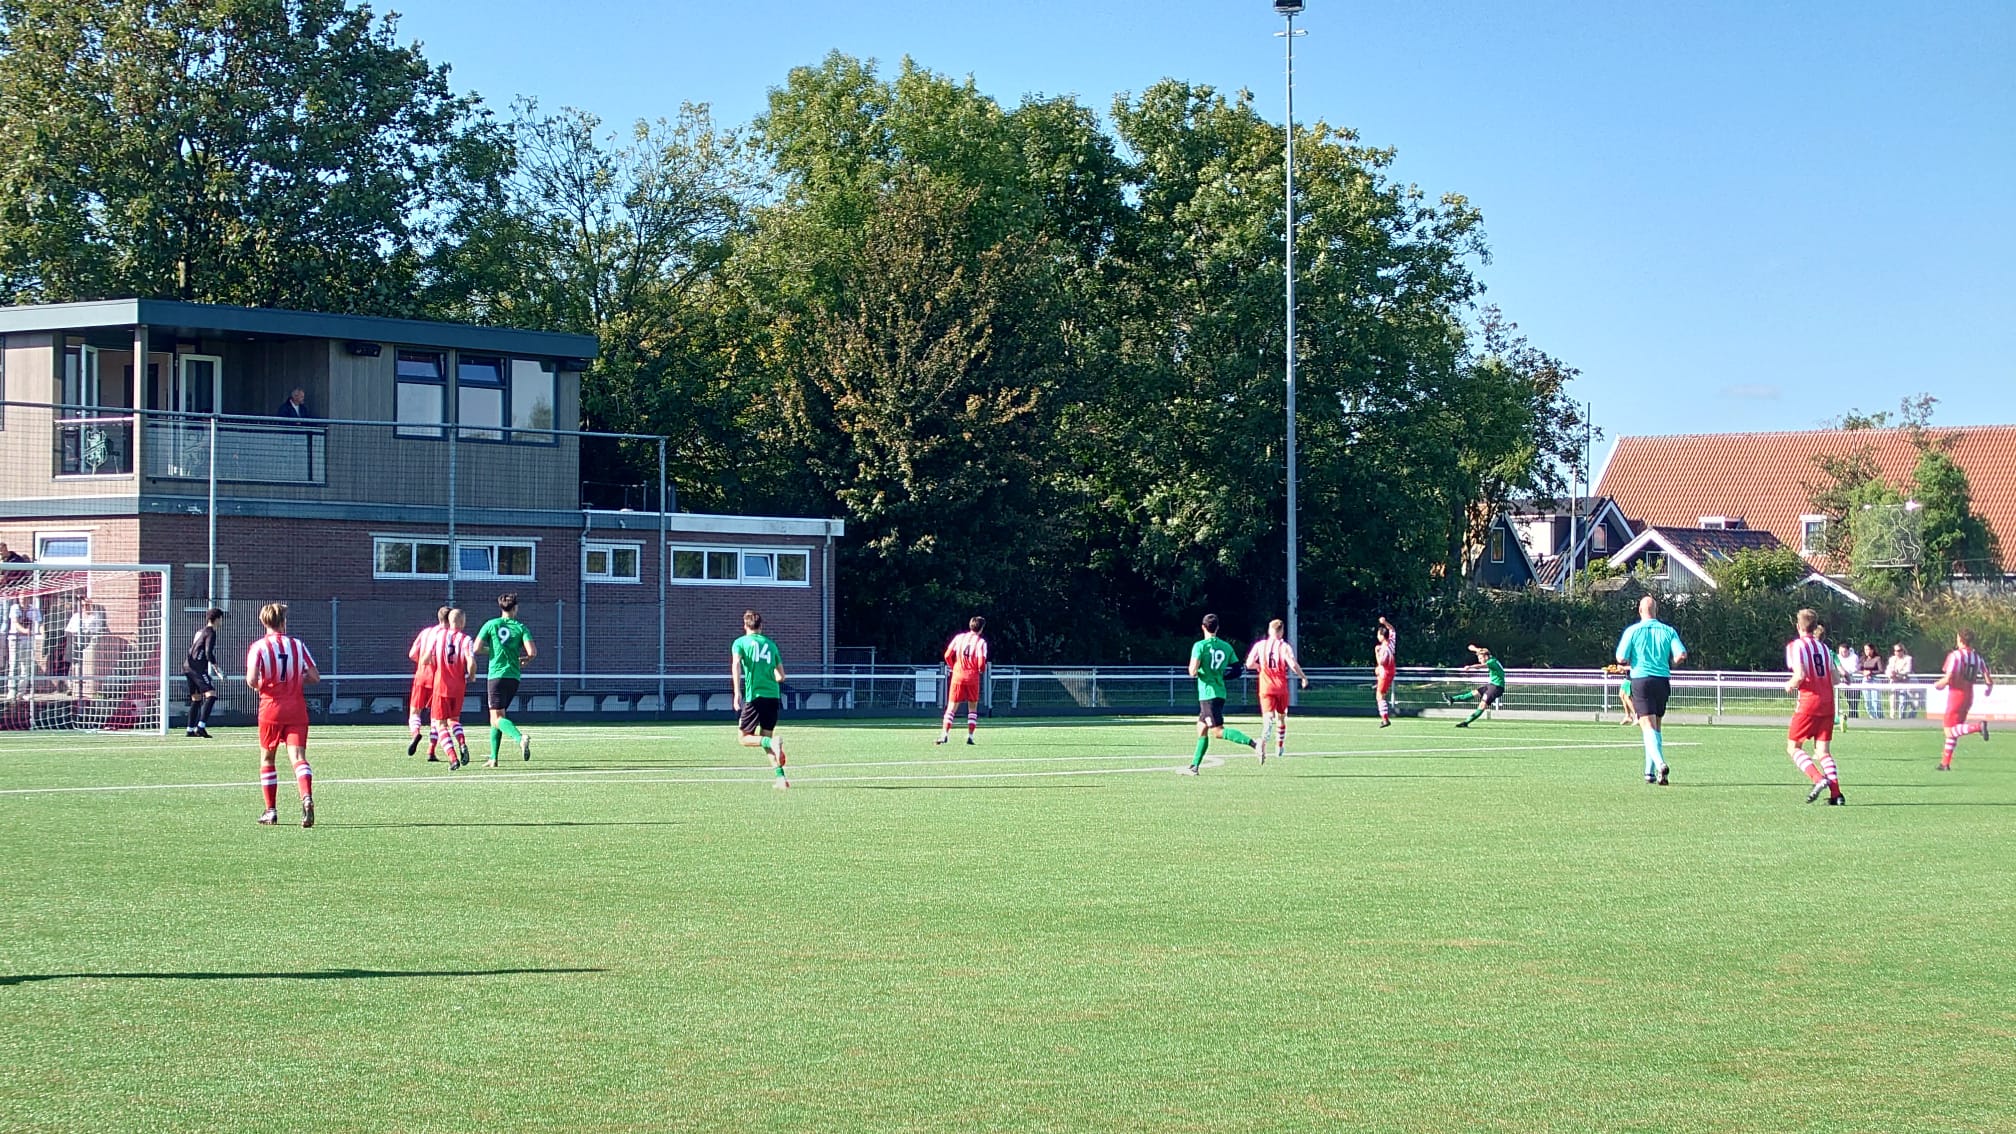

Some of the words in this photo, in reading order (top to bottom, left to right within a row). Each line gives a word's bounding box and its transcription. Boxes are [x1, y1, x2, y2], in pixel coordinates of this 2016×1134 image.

[498, 627, 511, 644] 9
[447, 645, 456, 664] 2
[752, 640, 771, 664] 14
[963, 644, 971, 658] 4
[1210, 647, 1225, 670] 19
[278, 653, 288, 681] 7
[1813, 653, 1825, 676] 8
